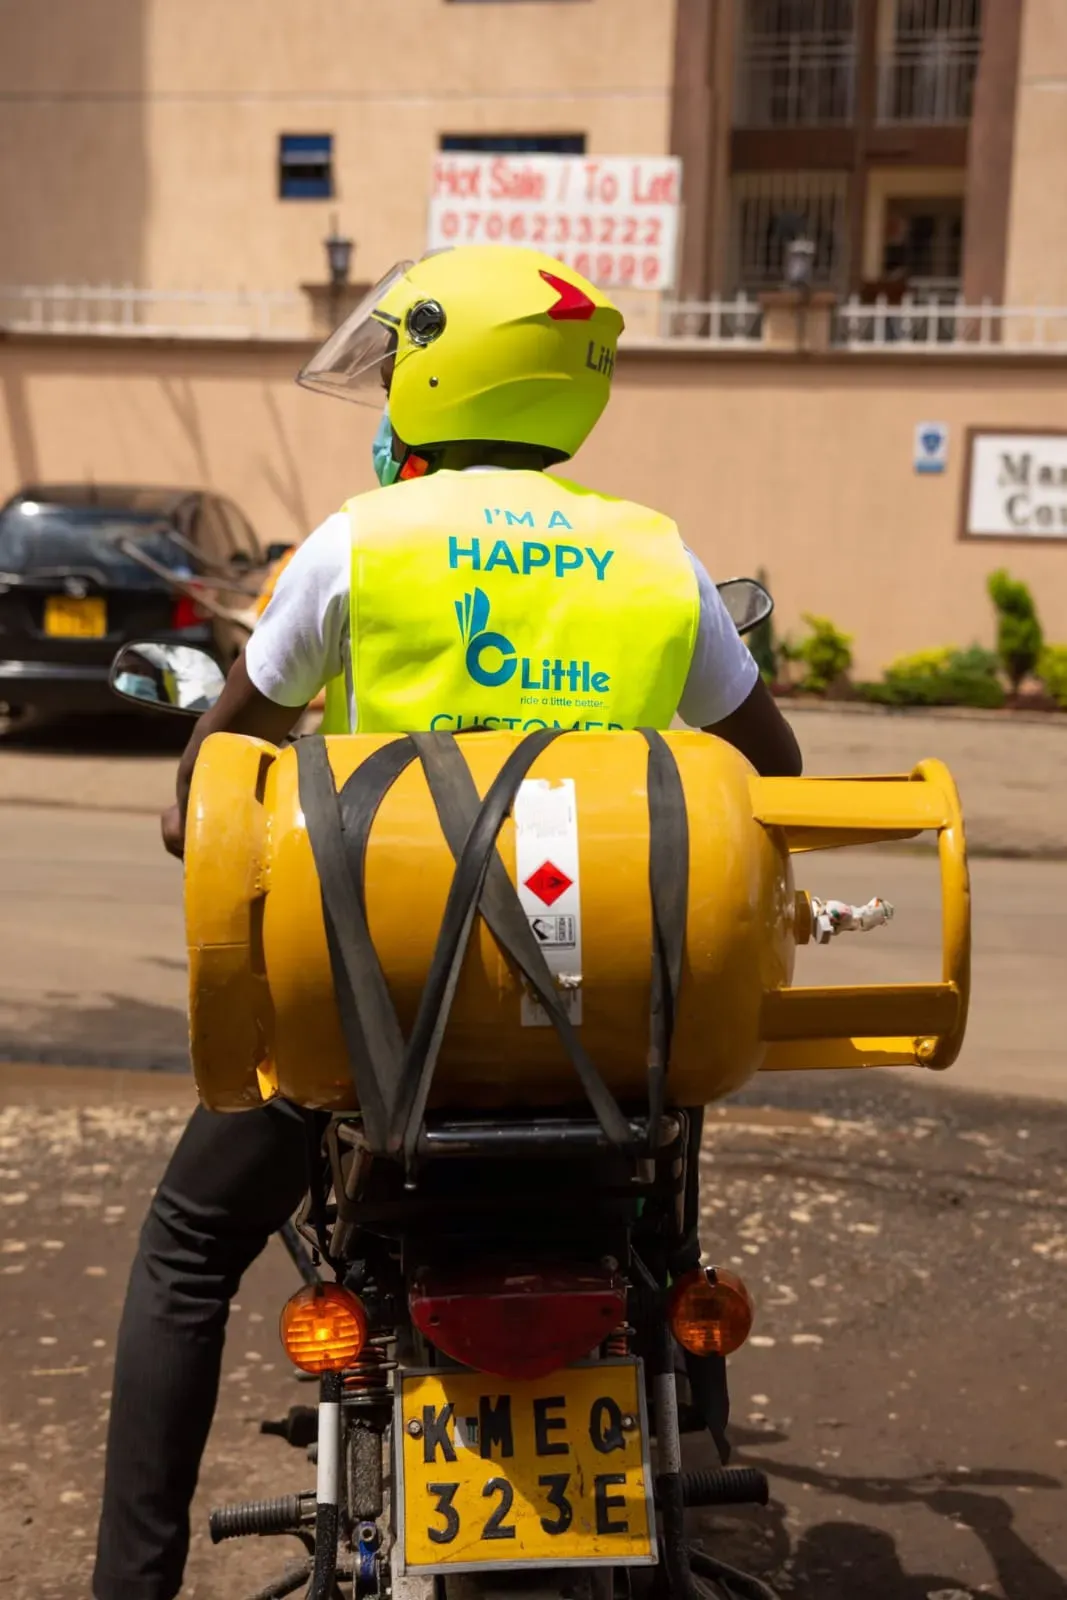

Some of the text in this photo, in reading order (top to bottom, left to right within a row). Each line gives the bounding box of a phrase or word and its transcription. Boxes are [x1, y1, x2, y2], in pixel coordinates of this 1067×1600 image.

[585, 164, 618, 203] To
[630, 166, 677, 206] Let
[484, 508, 573, 530] I'M A
[448, 536, 614, 580] HAPPY
[521, 658, 611, 692] Little
[520, 696, 539, 705] ride
[551, 697, 572, 707] little
[423, 1395, 625, 1462] KMEQ
[428, 1474, 629, 1543] 323E
